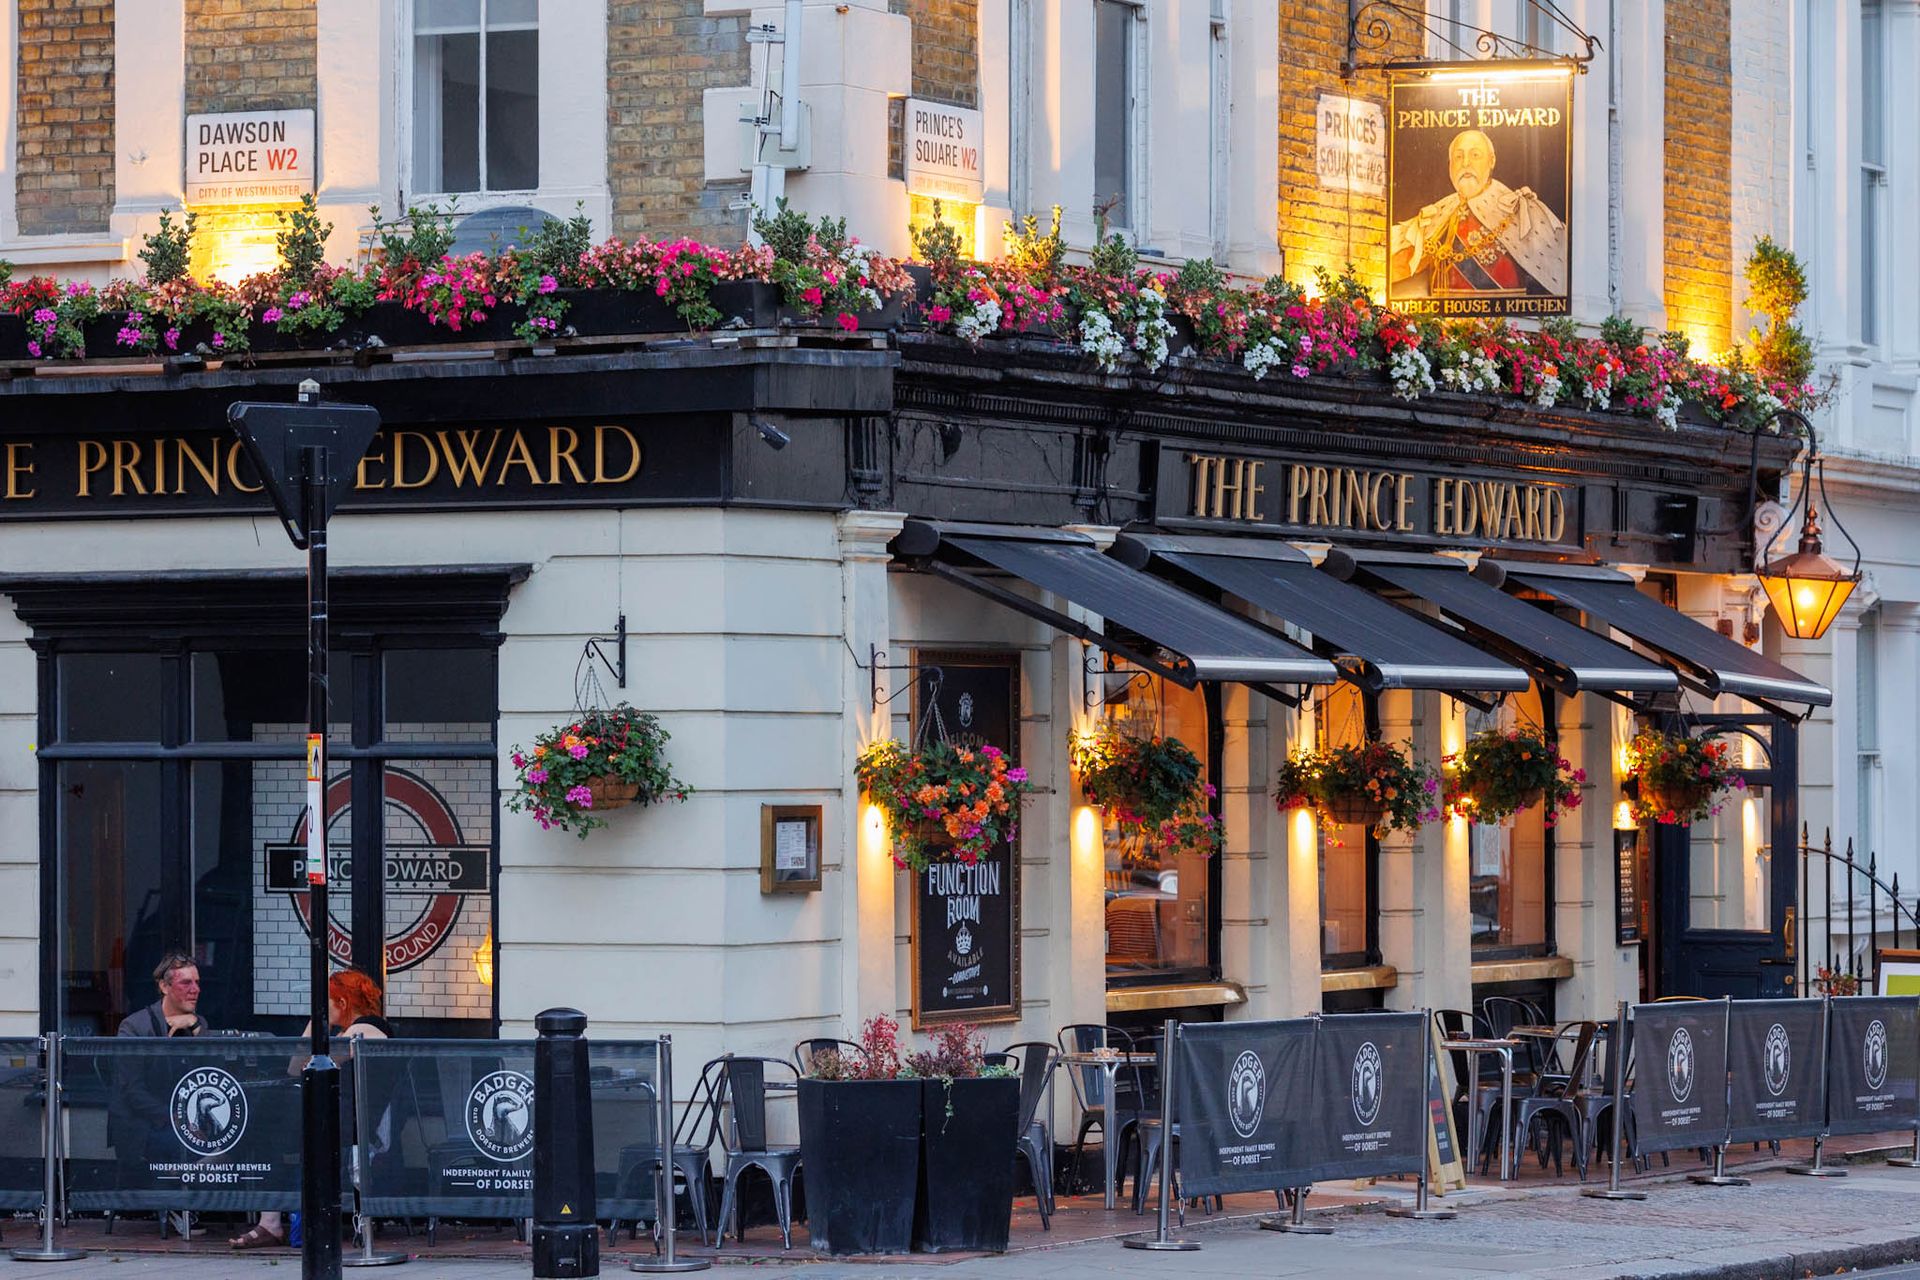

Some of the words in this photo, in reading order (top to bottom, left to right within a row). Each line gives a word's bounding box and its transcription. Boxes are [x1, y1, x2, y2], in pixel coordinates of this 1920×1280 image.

[1457, 87, 1500, 107] THE
[916, 110, 963, 140] PRINCE'S
[1397, 109, 1471, 129] PRINCE
[1477, 107, 1561, 128] EDWARD
[199, 121, 285, 146] DAWSON
[199, 150, 258, 173] PLACE
[266, 148, 298, 171] W2
[916, 139, 958, 167] SQUARE
[961, 147, 977, 171] W2
[198, 187, 218, 199] CITY
[221, 187, 231, 198] OF
[235, 185, 300, 197] WESTMINSTER
[1391, 299, 1440, 314] PUBLIC
[1443, 299, 1491, 314] HOUSE
[1495, 301, 1501, 313] &
[1506, 299, 1567, 313] KITCHEN
[76, 438, 265, 497] PRINC
[353, 425, 642, 489] EDWARD
[1191, 453, 1265, 521] THE
[1287, 463, 1415, 532] PRINCE
[1434, 476, 1565, 542] EDWARD
[385, 860, 463, 881] DWARD
[928, 861, 1001, 896] FUNCTION
[947, 894, 981, 929] ROOM
[1232, 1055, 1262, 1083] BADGER
[1355, 1046, 1379, 1073] BADGER
[178, 1072, 239, 1100] BADGER
[180, 1123, 205, 1147] DORSET
[207, 1124, 238, 1149] BREWERS
[475, 1129, 501, 1153] DORSET
[1354, 1142, 1361, 1151] OF
[1362, 1141, 1378, 1151] DORSET
[149, 1163, 204, 1171] INDEPENDENT
[206, 1163, 234, 1171] FAMILY
[236, 1163, 271, 1171] BREWERS
[1232, 1155, 1240, 1165] OF
[1241, 1154, 1260, 1165] DORSET
[181, 1173, 196, 1183] OF
[199, 1173, 239, 1183] DORSET
[442, 1168, 499, 1177] INDEPENDENT
[502, 1169, 532, 1177] FAMILY
[476, 1179, 491, 1189] OF
